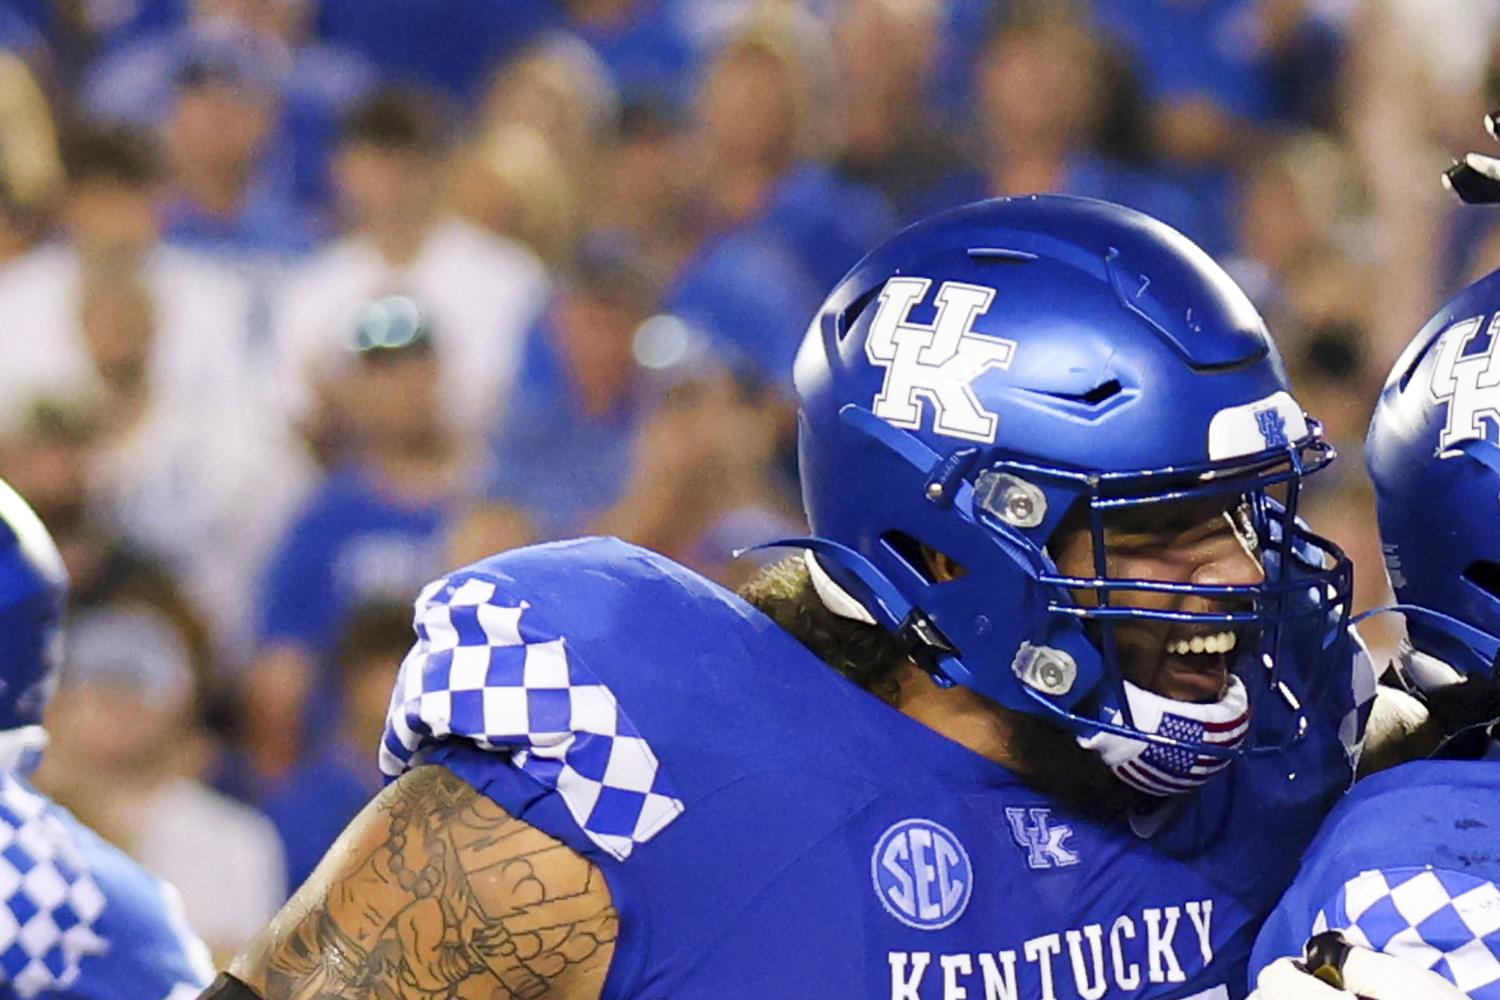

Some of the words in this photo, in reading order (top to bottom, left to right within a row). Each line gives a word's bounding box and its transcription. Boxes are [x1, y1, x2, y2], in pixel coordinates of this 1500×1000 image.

[864, 276, 1018, 443] UK
[880, 828, 964, 920] SEC
[1005, 806, 1082, 869] UK
